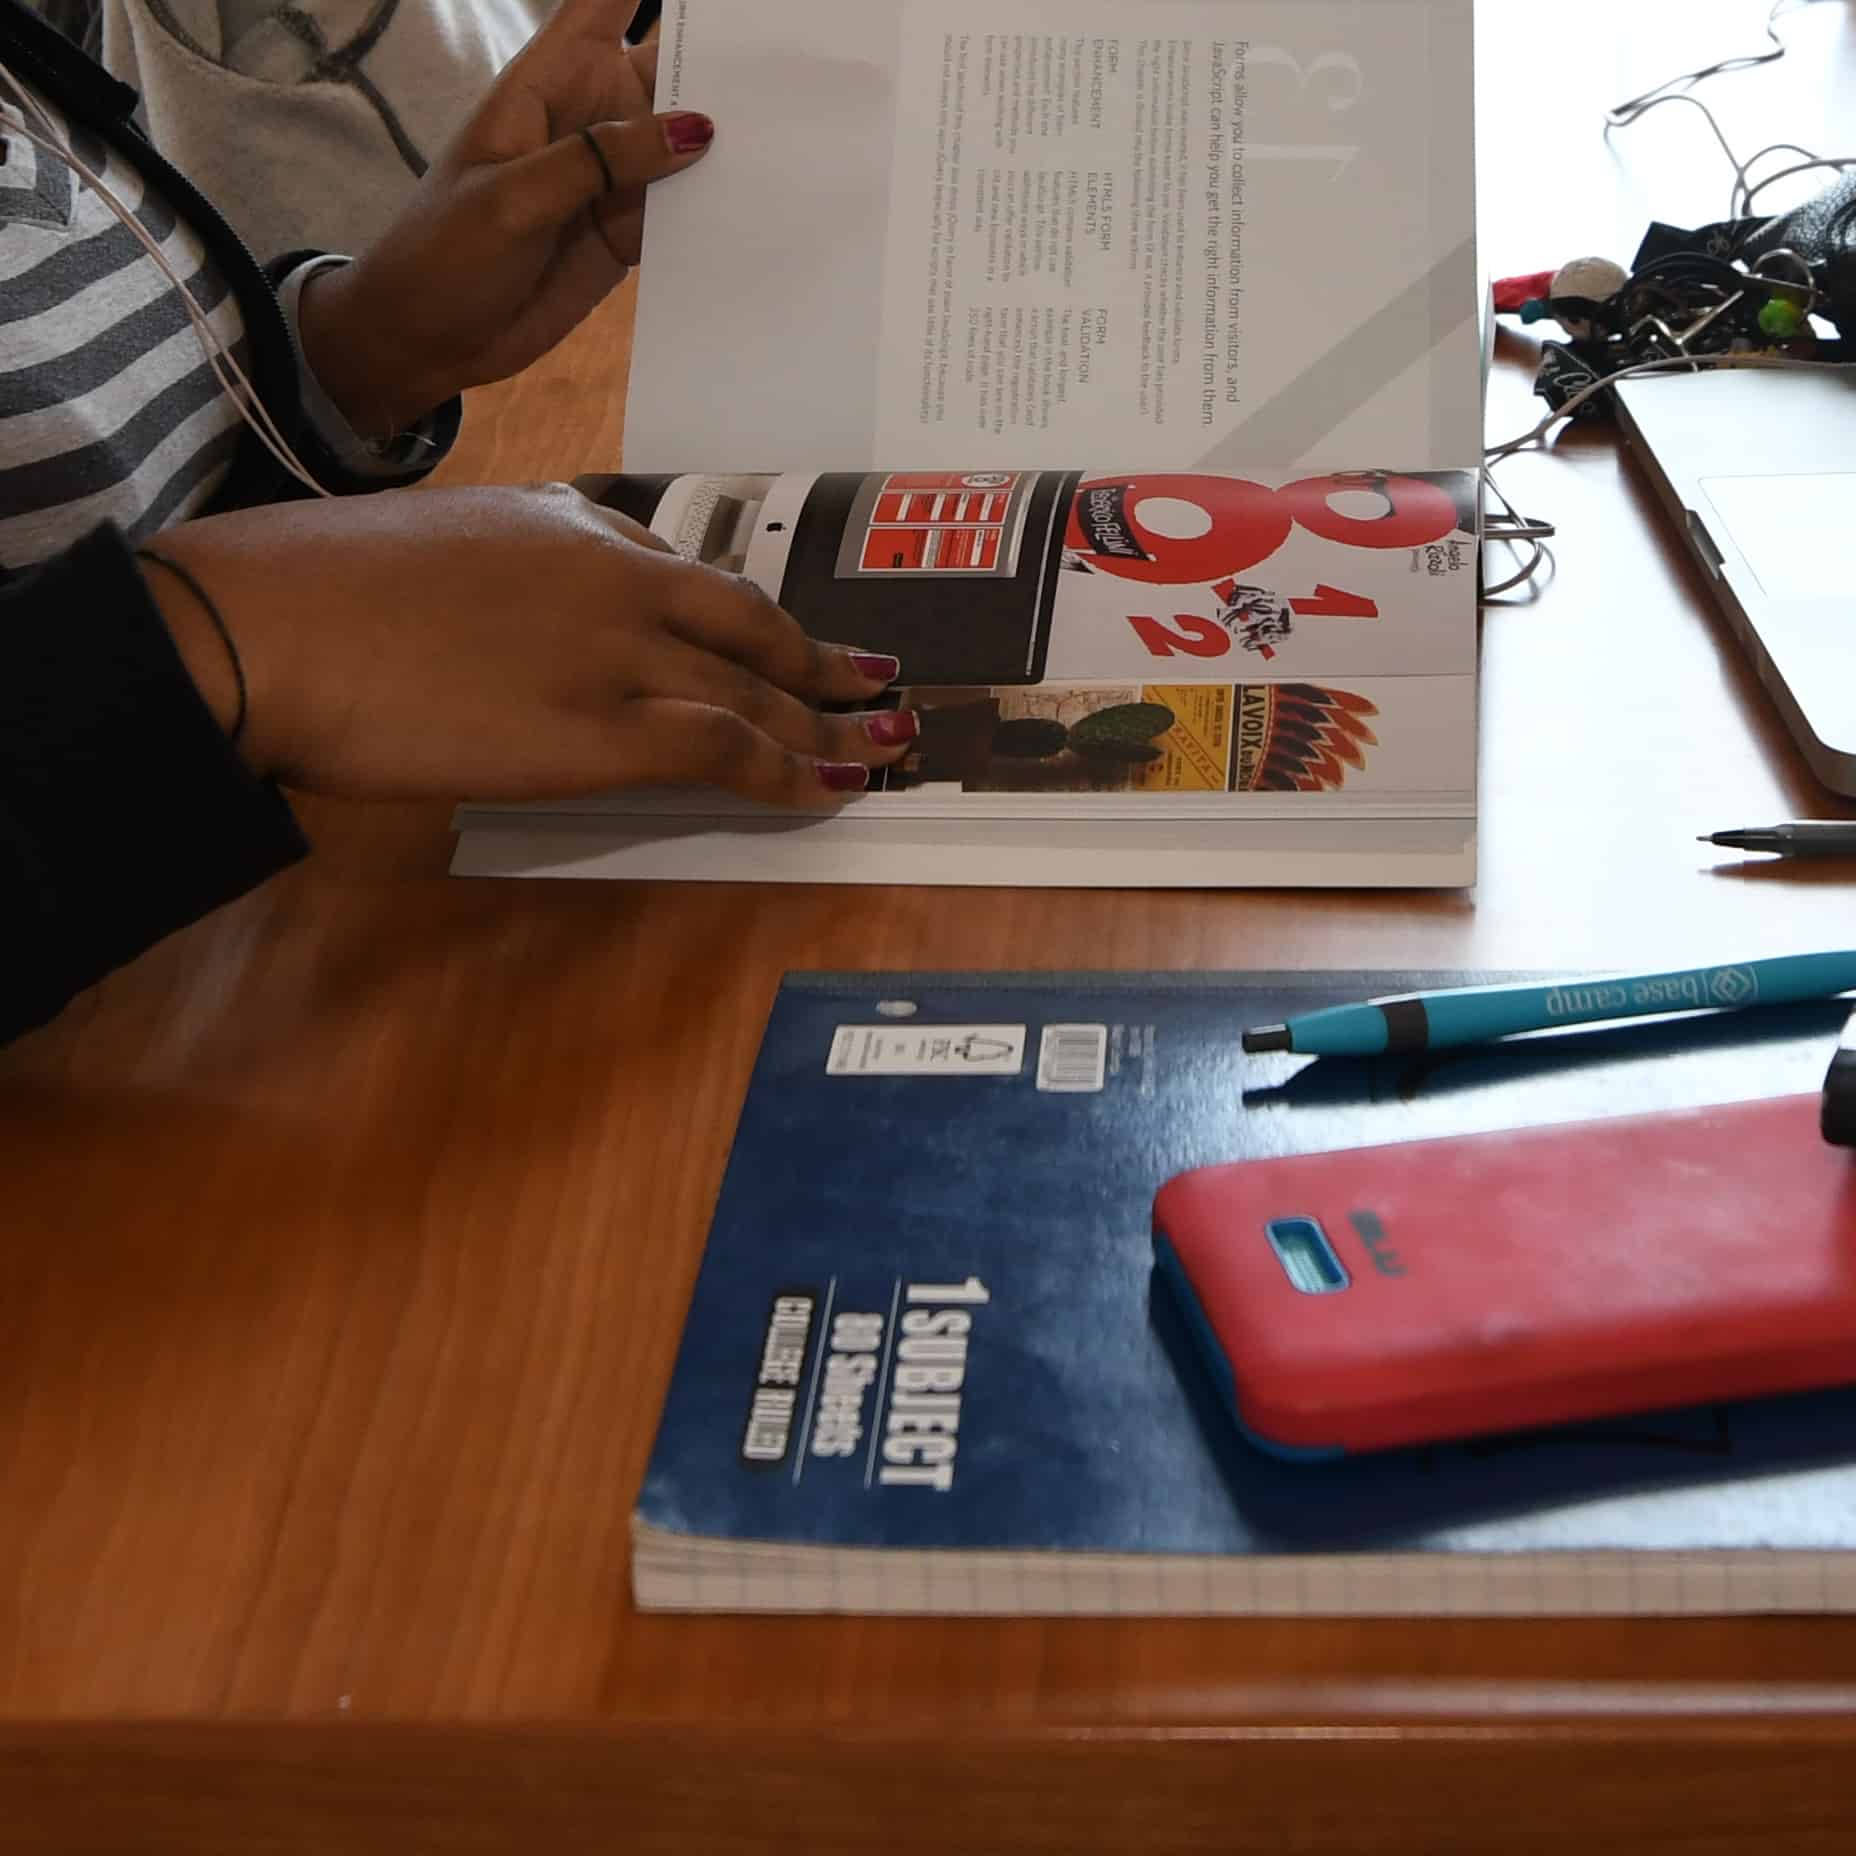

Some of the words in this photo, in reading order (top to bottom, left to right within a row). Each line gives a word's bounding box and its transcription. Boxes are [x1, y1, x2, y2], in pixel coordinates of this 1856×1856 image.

[671, 22, 685, 97] ENHANCEMENT
[1108, 39, 1118, 72] FORM
[1207, 41, 1225, 105] JavaScript
[1235, 40, 1249, 80] Forms
[1090, 39, 1102, 129] ENHANCEMENT
[1234, 82, 1248, 116] allow
[1210, 108, 1219, 130] can
[1230, 119, 1243, 143] you
[1205, 133, 1223, 161] help
[1233, 146, 1246, 160] to
[1102, 172, 1113, 212] HTML5
[1205, 164, 1218, 188] you
[1232, 163, 1246, 205] collect
[1085, 172, 1096, 233] ELEMENTS
[1204, 191, 1221, 212] get
[1100, 215, 1111, 250] FORM
[1207, 215, 1221, 237] the
[1202, 240, 1220, 271] right
[1229, 208, 1245, 285] information
[1203, 274, 1219, 352] information
[1228, 288, 1243, 320] from
[1095, 308, 1106, 344] FORM
[1078, 309, 1091, 383] VALIDATION
[1225, 323, 1241, 374] visitors,
[1202, 355, 1217, 387] from
[1226, 377, 1240, 403] and
[1201, 390, 1216, 429] them.
[1240, 706, 1265, 749] VOIX
[1545, 986, 1628, 1016] camp
[1633, 976, 1698, 1005] base
[906, 1276, 990, 1305] 1
[810, 1353, 880, 1458] Sheets
[880, 1307, 972, 1492] SUBJECT
